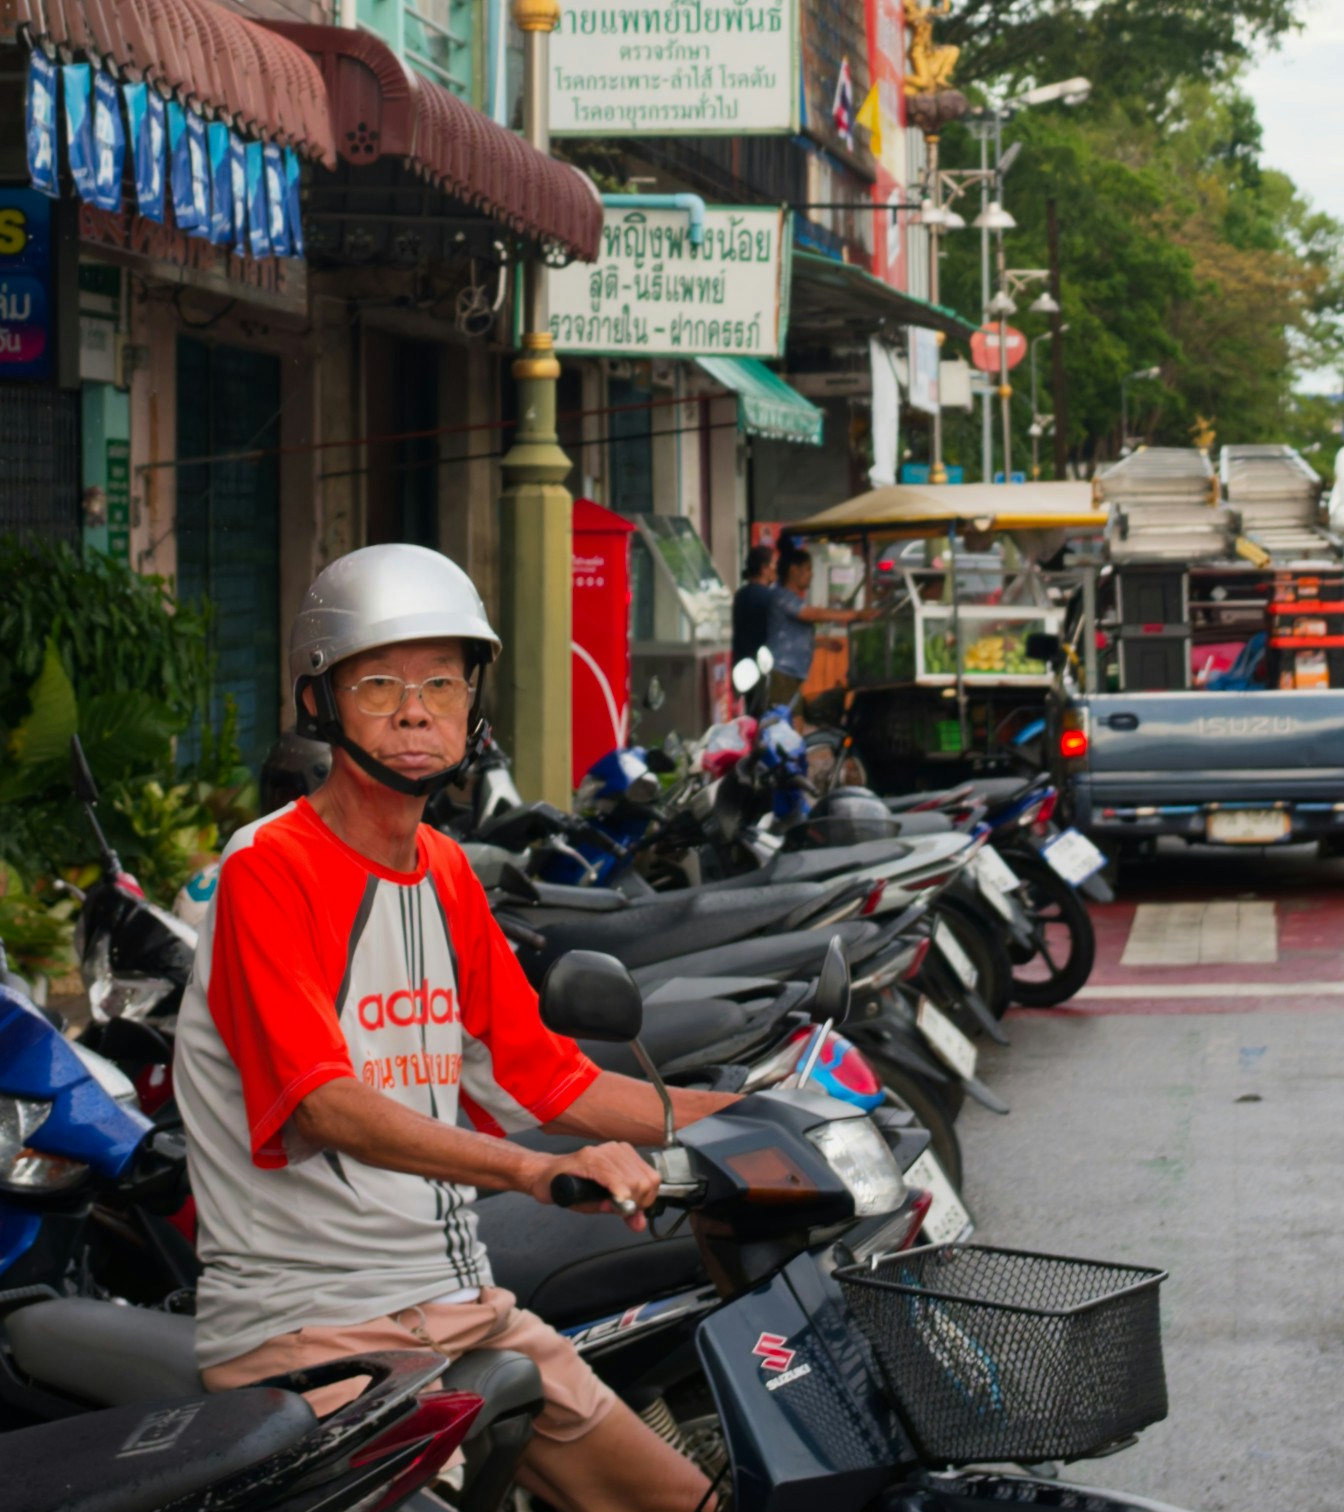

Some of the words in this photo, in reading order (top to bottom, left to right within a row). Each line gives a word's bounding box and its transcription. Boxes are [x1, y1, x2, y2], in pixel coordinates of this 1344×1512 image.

[619, 39, 711, 62] ตรวจรักษา
[718, 63, 776, 89] โรคตับ
[571, 92, 739, 128] โรคอายุรกรรมทั่วไป
[602, 211, 772, 269] หญิงพงน้อย
[670, 310, 763, 349] ฝากครรภ์
[1197, 715, 1290, 734] ISUZU
